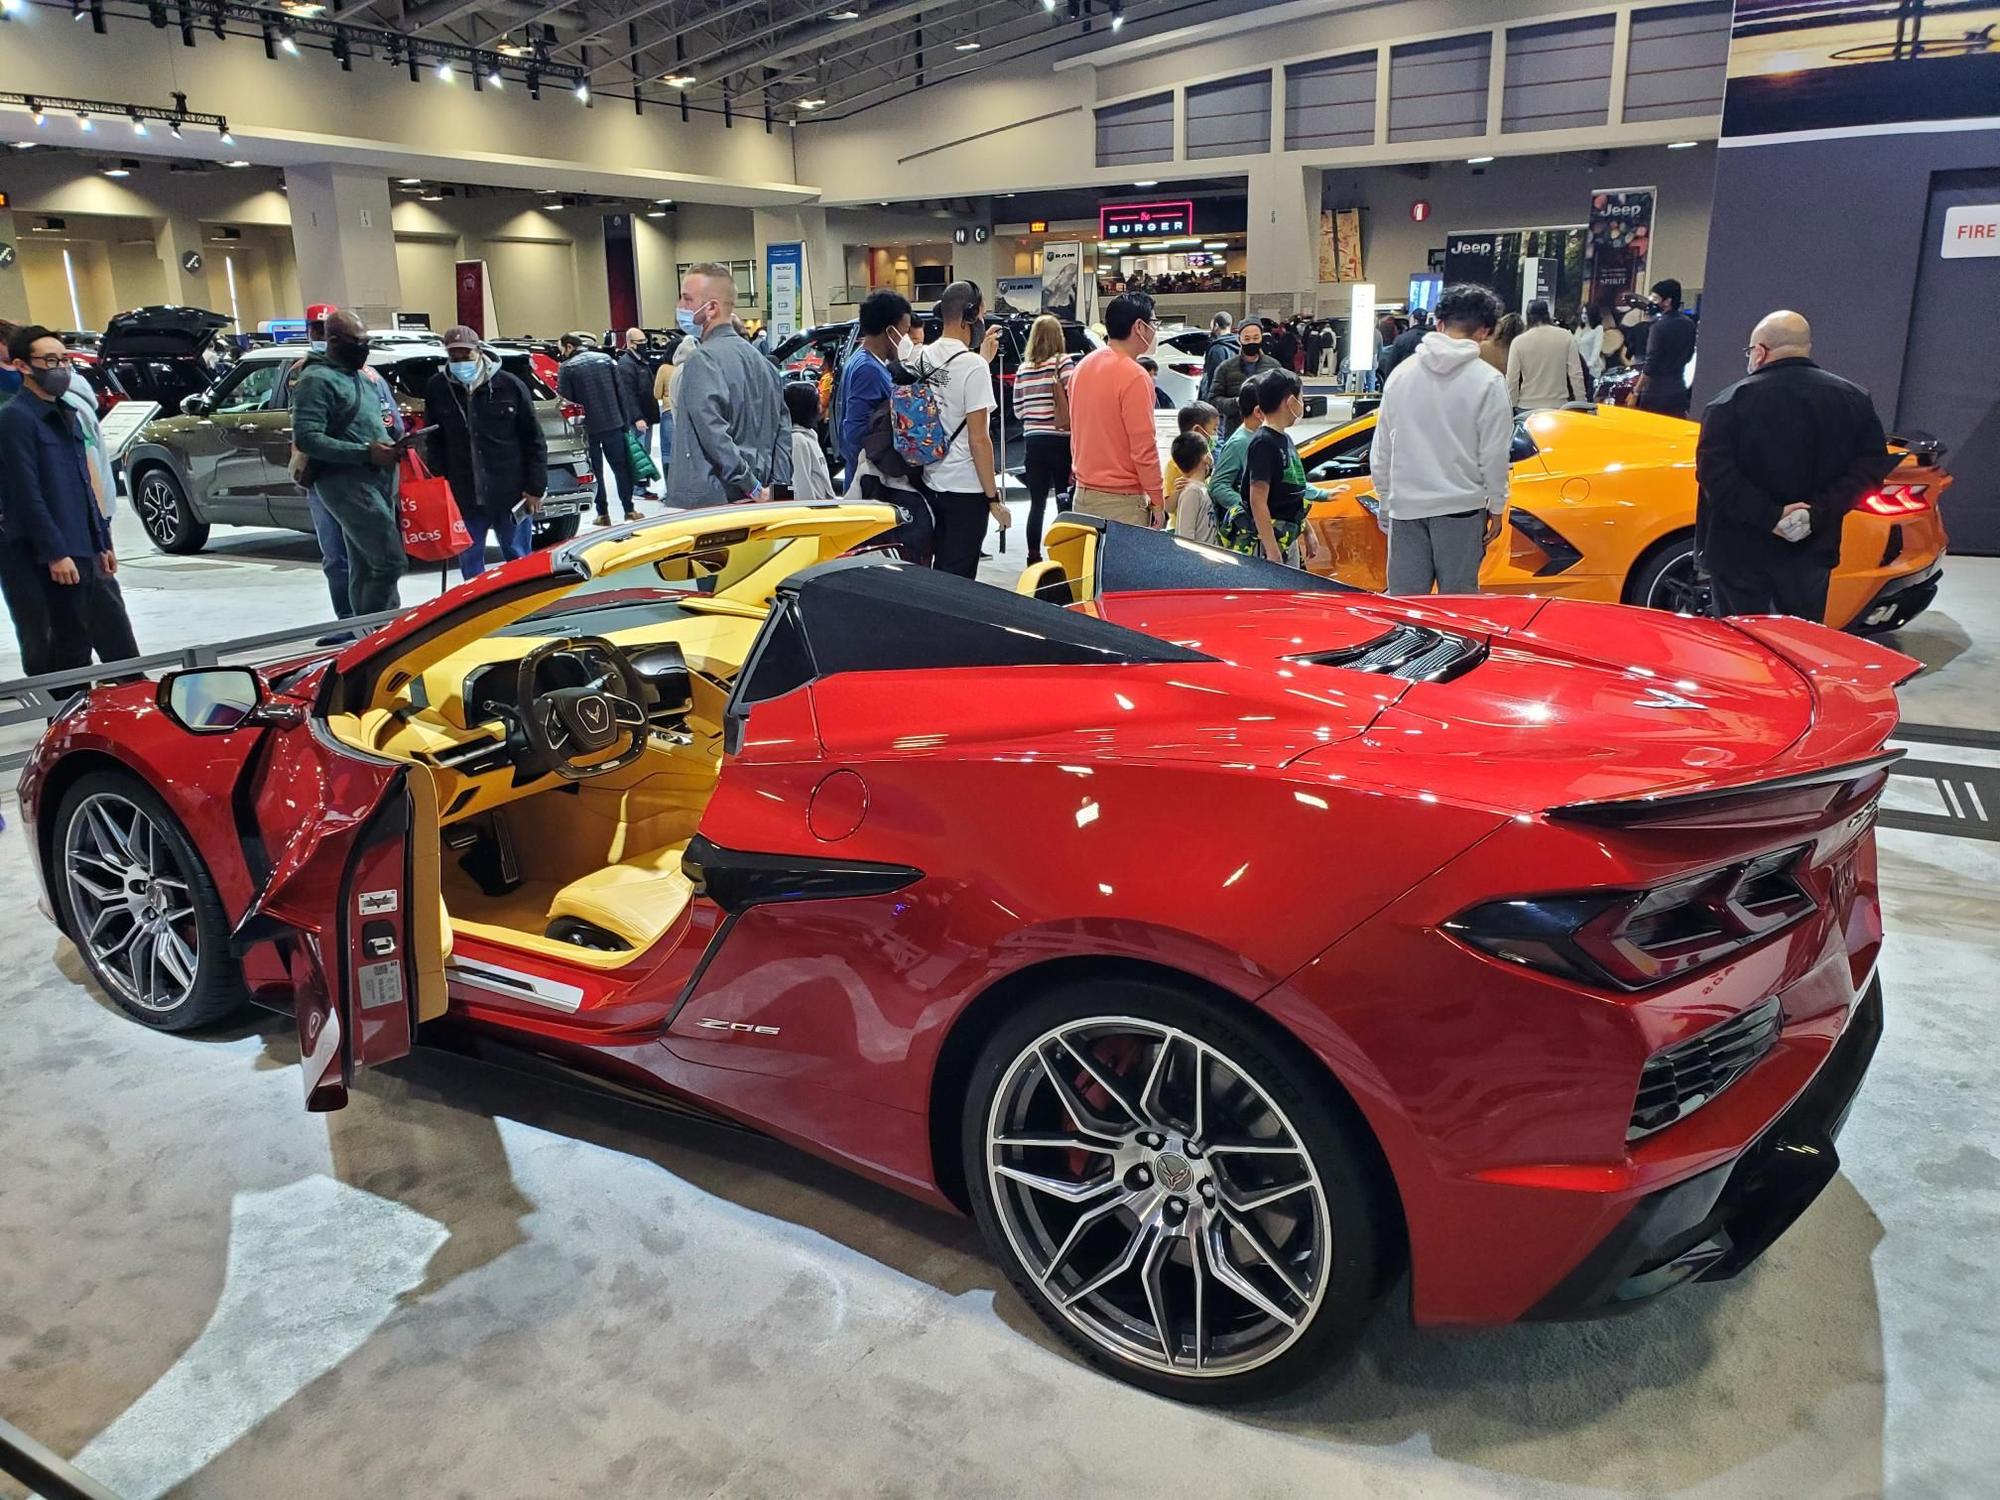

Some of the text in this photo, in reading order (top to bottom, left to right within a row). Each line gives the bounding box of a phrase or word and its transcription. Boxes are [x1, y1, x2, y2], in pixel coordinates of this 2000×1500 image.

[1601, 203, 1641, 217] Jeep
[1109, 221, 1183, 234] BURGER
[1957, 224, 1997, 239] FIRE
[1450, 241, 1491, 256] Jeep
[403, 529, 442, 545] laces
[695, 1017, 780, 1035] Z06
